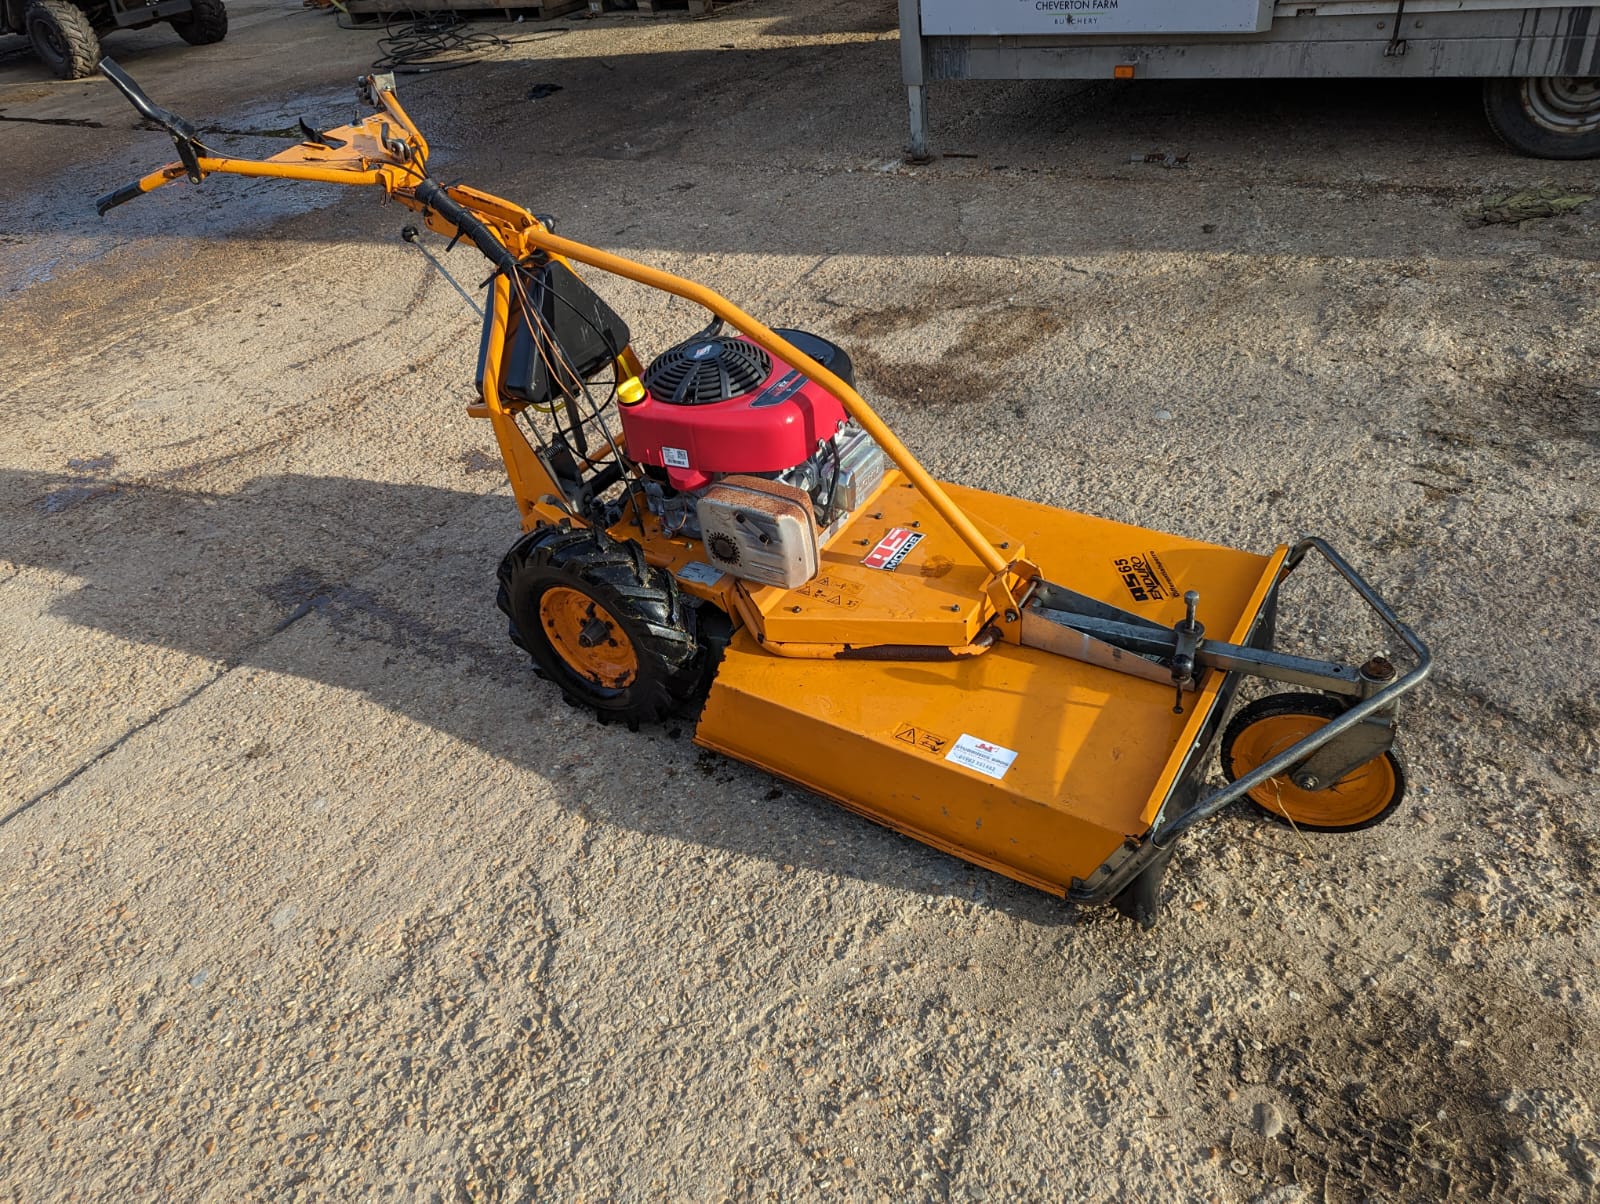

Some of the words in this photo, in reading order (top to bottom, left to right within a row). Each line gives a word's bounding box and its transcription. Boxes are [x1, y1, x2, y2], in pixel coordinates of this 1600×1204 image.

[1035, 0, 1090, 11] CHEVERTON
[1092, 0, 1119, 9] FARM
[1054, 17, 1098, 25] BUCHERY
[884, 534, 920, 569] MOTOR
[1130, 556, 1164, 601] ENDURO
